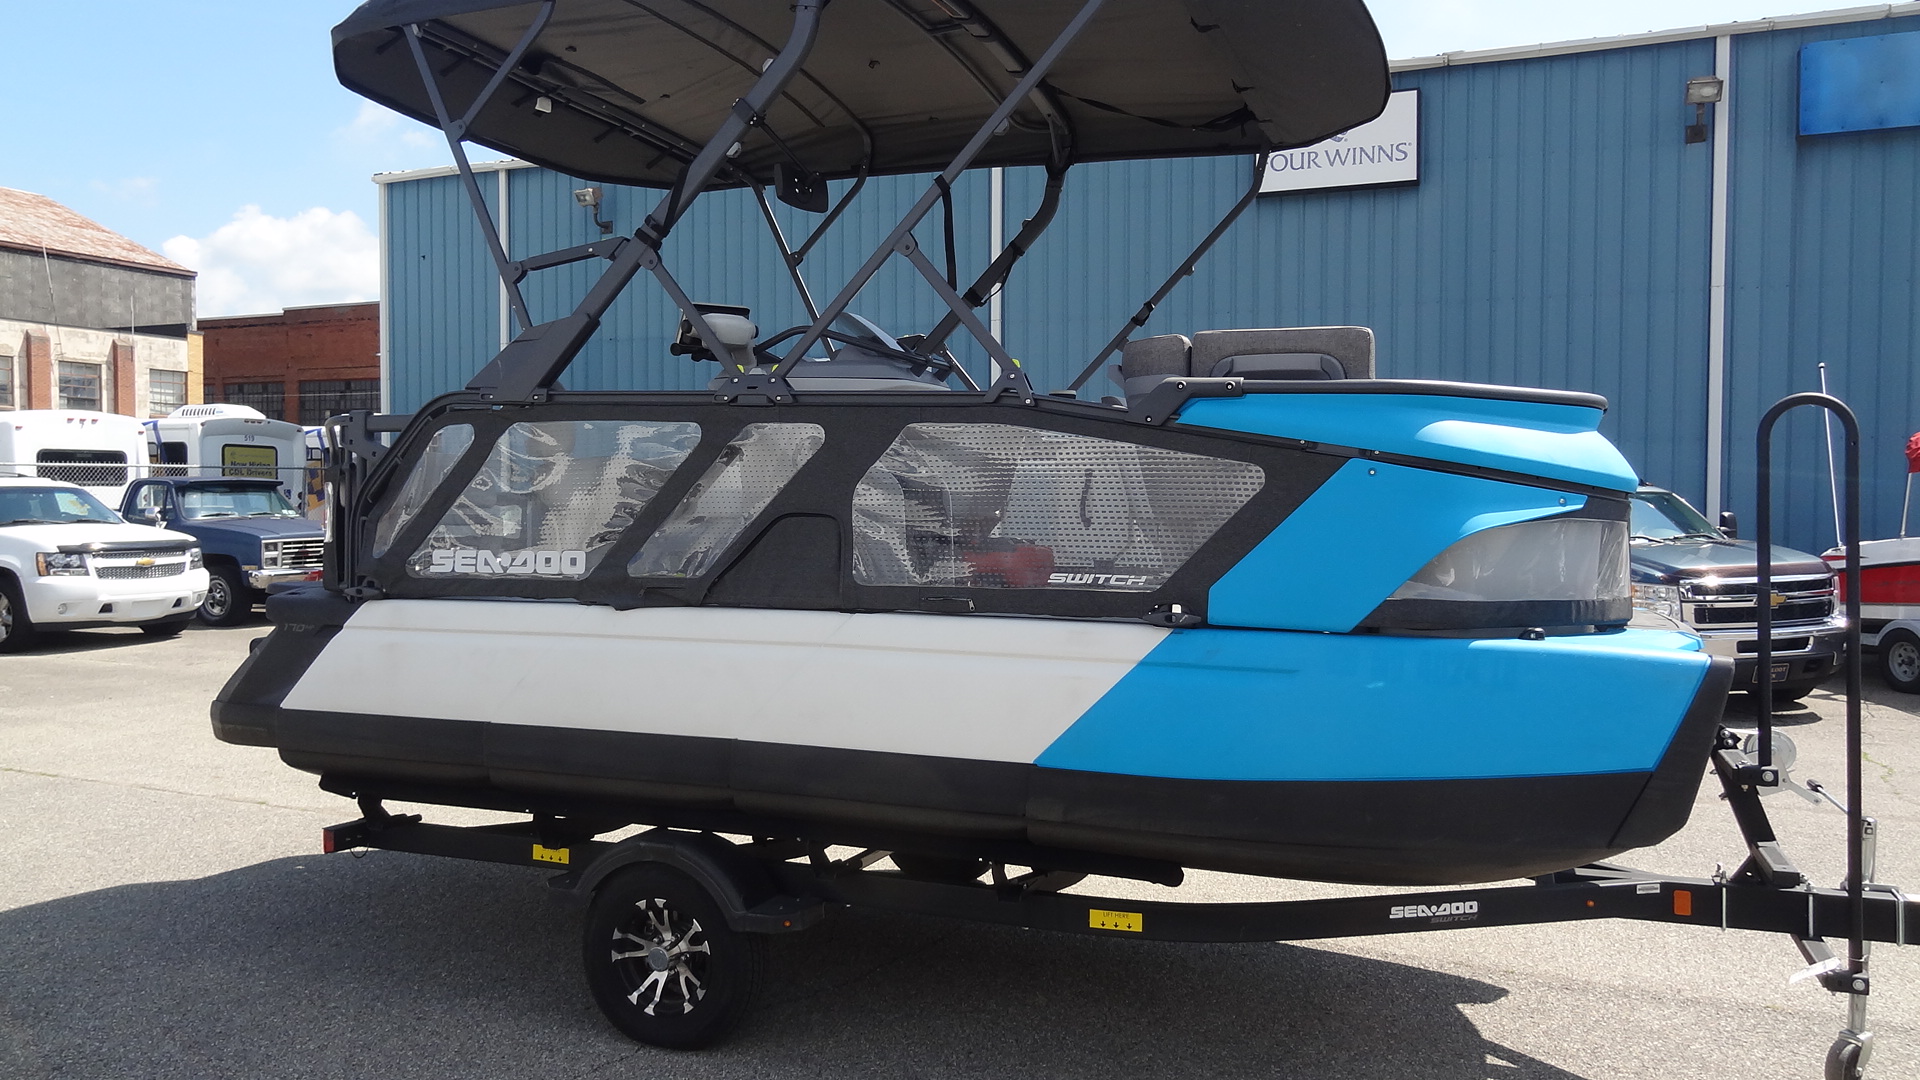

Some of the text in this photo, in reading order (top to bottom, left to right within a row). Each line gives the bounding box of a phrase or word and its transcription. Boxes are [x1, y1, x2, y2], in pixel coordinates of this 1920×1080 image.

[1266, 142, 1409, 172] OUR WINNS
[1047, 573, 1147, 586] SWITCH
[1430, 914, 1478, 924] SWITCH
